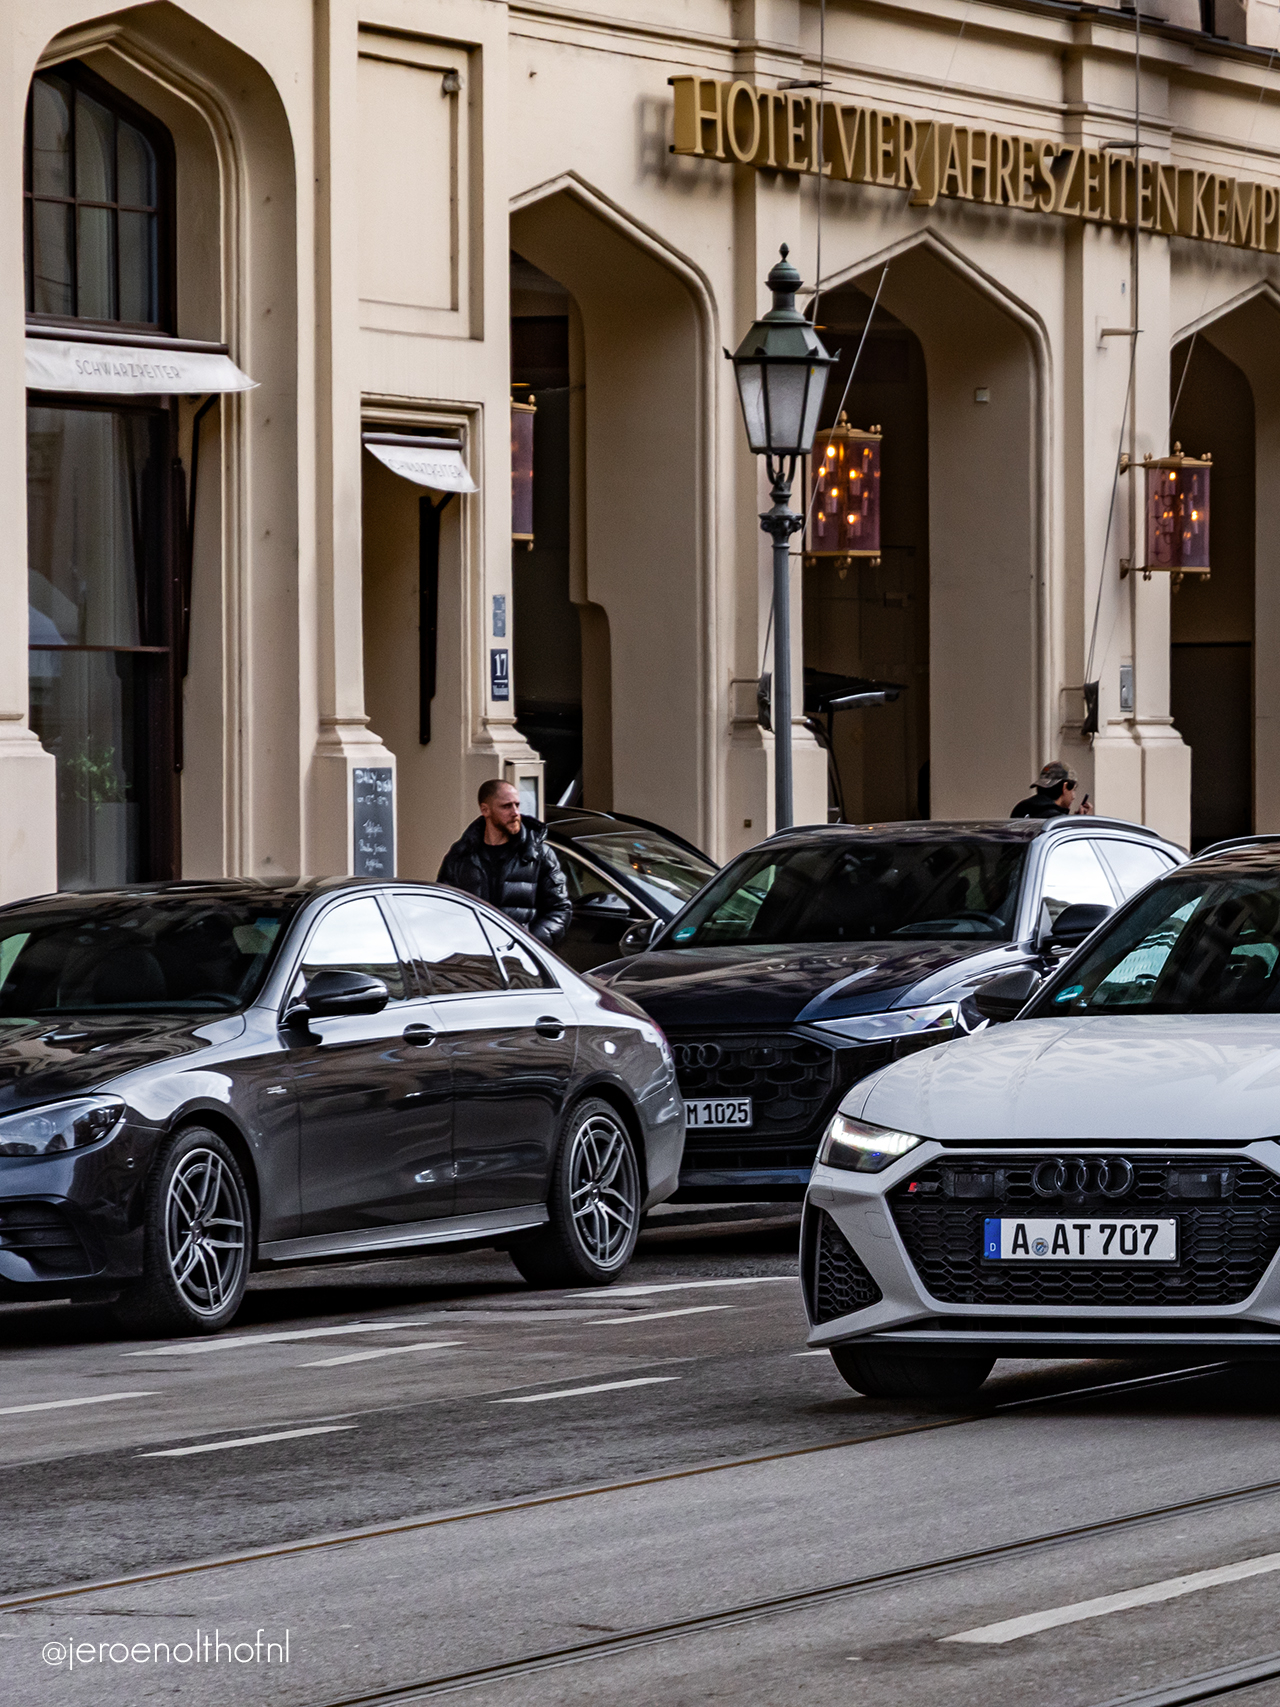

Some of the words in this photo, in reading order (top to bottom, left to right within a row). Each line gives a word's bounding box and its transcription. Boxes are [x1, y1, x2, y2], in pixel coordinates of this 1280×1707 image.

[694, 76, 832, 176] HOTEL
[835, 104, 922, 191] VIER
[926, 120, 1179, 234] JAHRESZEITEN
[75, 359, 181, 379] SCHWARZREITER
[495, 653, 507, 676] 17
[686, 1104, 698, 1125] M
[702, 1102, 749, 1125] 1025
[1011, 1223, 1030, 1255] A
[1051, 1223, 1092, 1255] AT
[1099, 1223, 1159, 1256] 707
